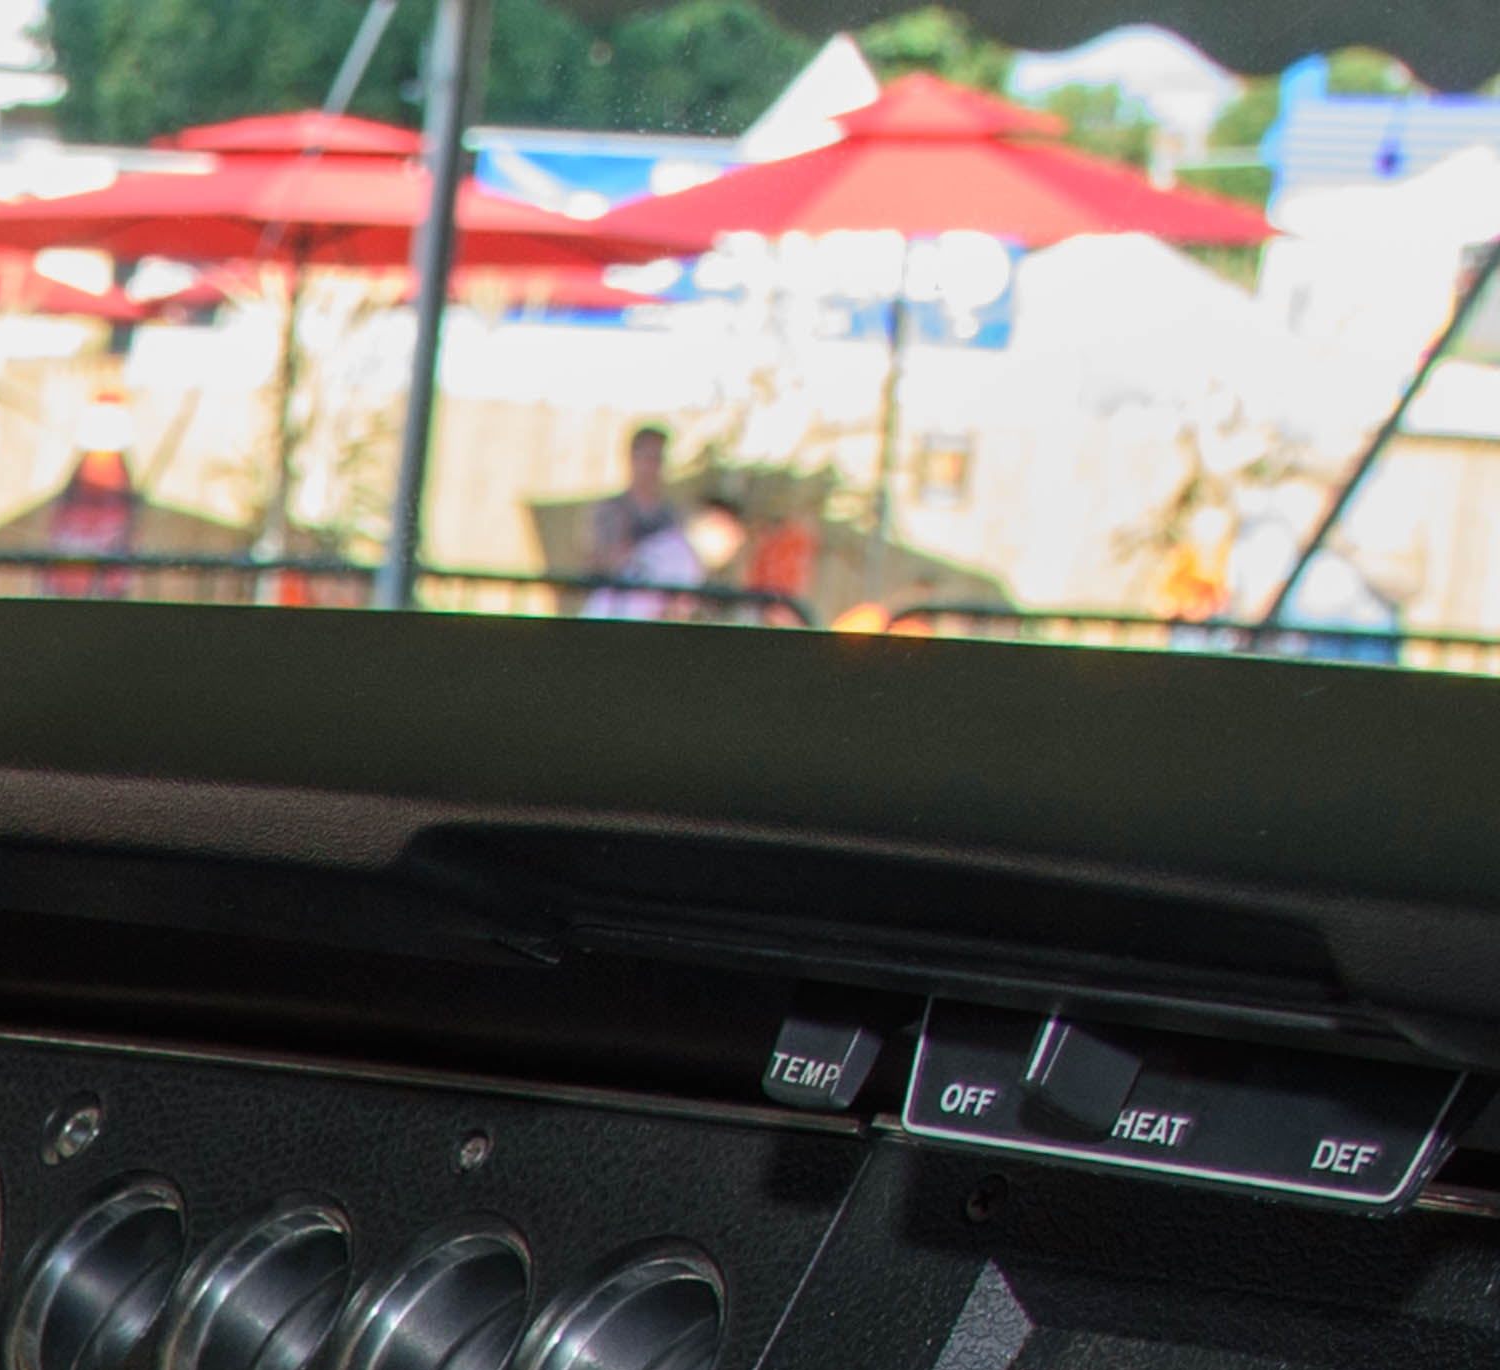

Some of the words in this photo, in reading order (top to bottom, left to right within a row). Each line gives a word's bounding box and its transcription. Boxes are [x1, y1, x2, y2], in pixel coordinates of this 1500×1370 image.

[769, 1052, 840, 1089] TEMP
[940, 1084, 995, 1116] OFF
[1111, 1110, 1190, 1147] HEAT
[1310, 1139, 1378, 1175] DEF
